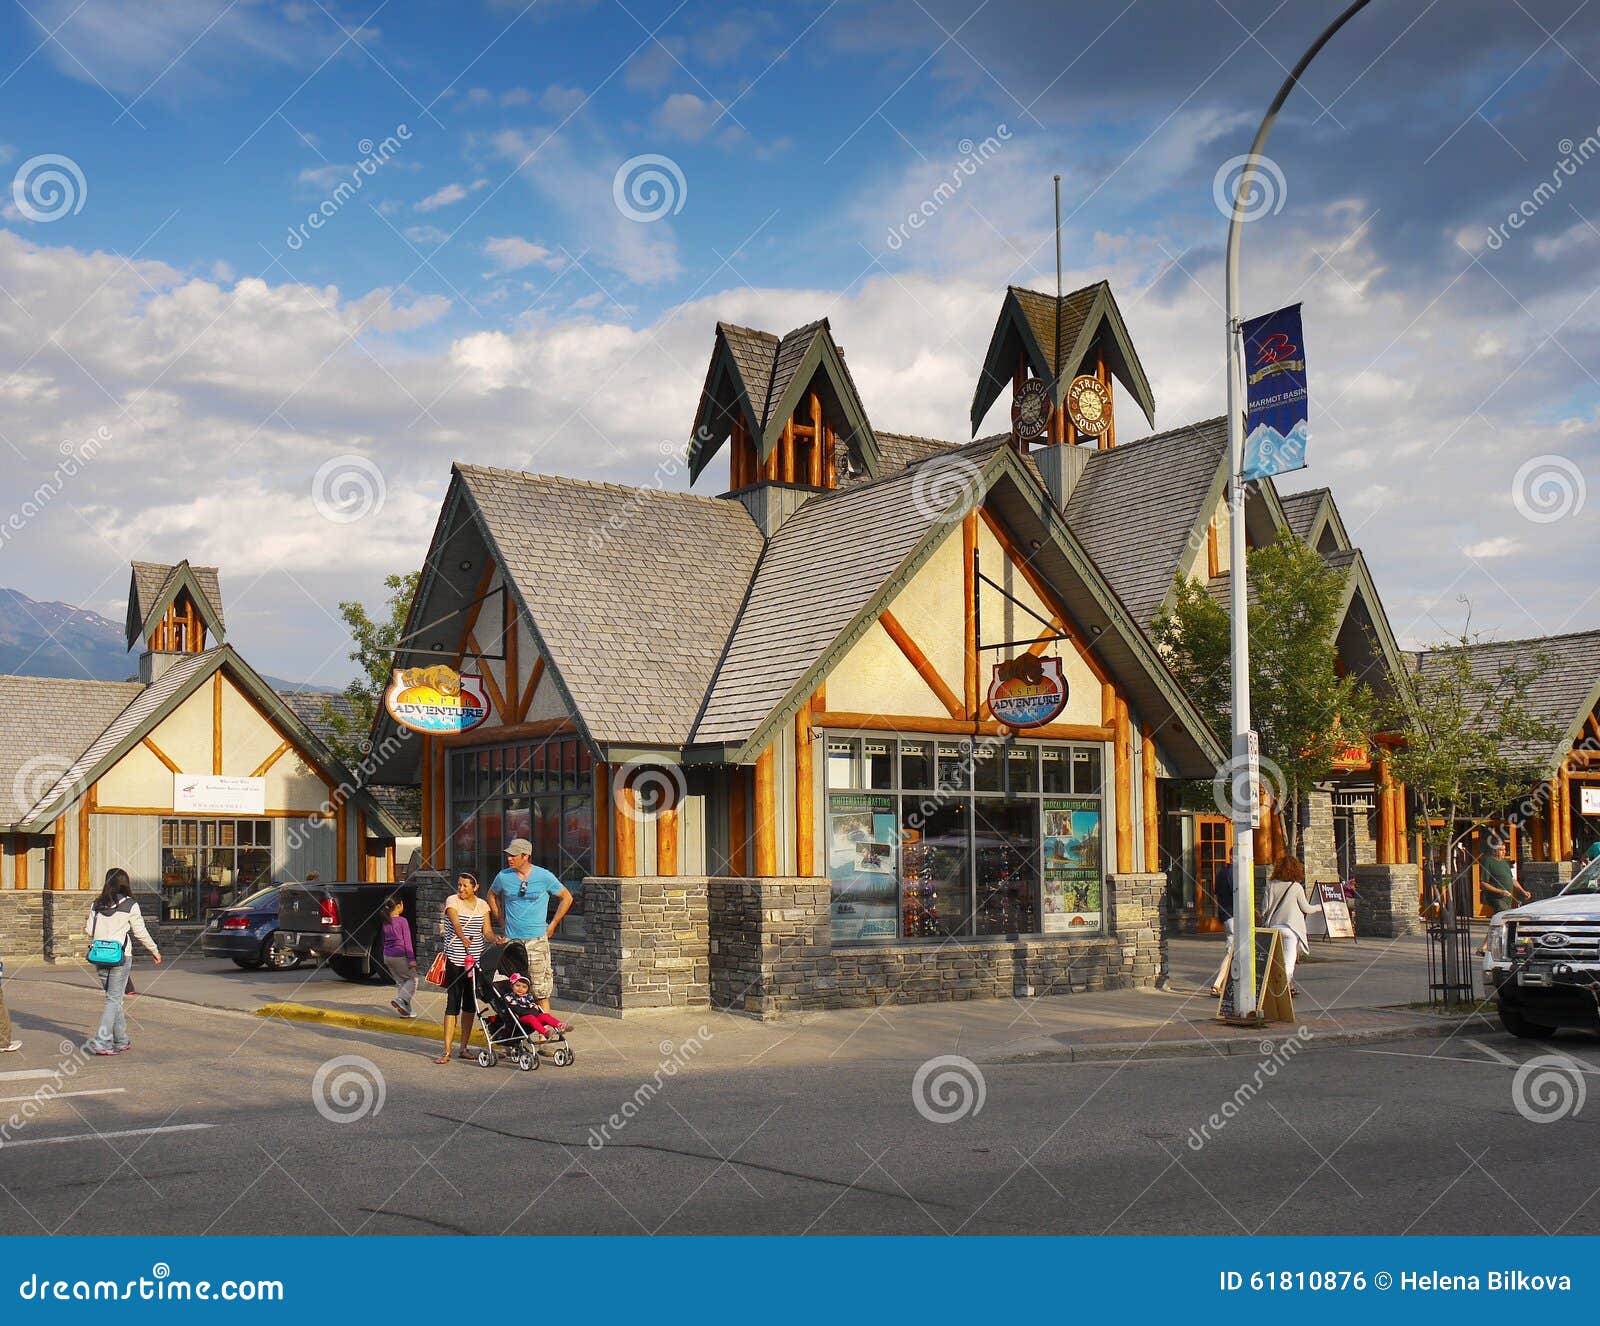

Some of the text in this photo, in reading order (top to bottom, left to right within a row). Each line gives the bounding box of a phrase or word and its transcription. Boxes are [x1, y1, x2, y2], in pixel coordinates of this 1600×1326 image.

[1014, 382, 1048, 408] PATRICIA
[1071, 379, 1108, 404] PATRICIA
[1249, 387, 1307, 409] MARMOT BASIN
[1017, 417, 1046, 436] SQUARE
[1075, 413, 1107, 433] SQUARE
[393, 703, 484, 718] ADVENTURE
[992, 694, 1061, 709] ADVENTURE
[1321, 884, 1334, 892] Now
[1325, 891, 1342, 900] Hiring
